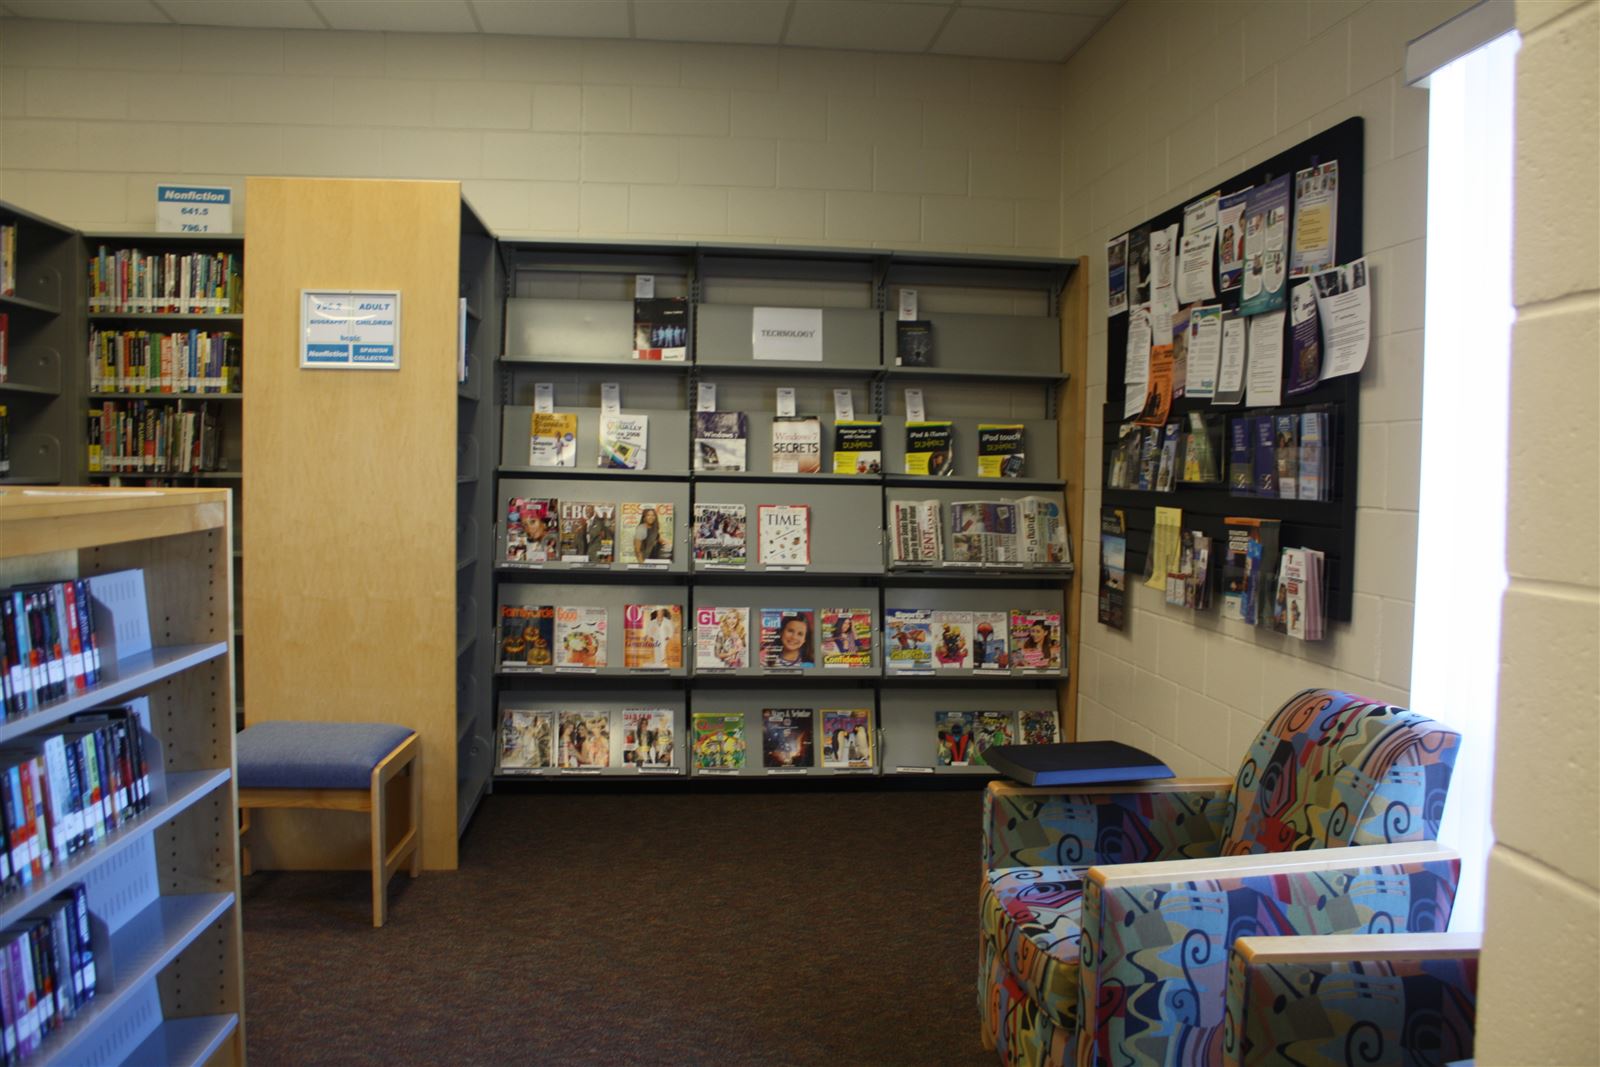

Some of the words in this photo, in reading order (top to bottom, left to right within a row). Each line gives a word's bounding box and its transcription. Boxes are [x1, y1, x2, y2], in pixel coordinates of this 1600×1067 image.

[164, 190, 225, 201] Nonfiction
[181, 207, 208, 216] 641.5
[359, 303, 390, 311] ADULT
[761, 329, 816, 338] TECHNOLOGY
[308, 350, 349, 358] Nonfiction
[703, 430, 733, 439] Windows
[982, 432, 998, 442] iPod
[999, 431, 1021, 441] touch
[774, 442, 818, 453] SECRETS
[766, 514, 801, 526] TIME
[762, 616, 781, 629] Girl
